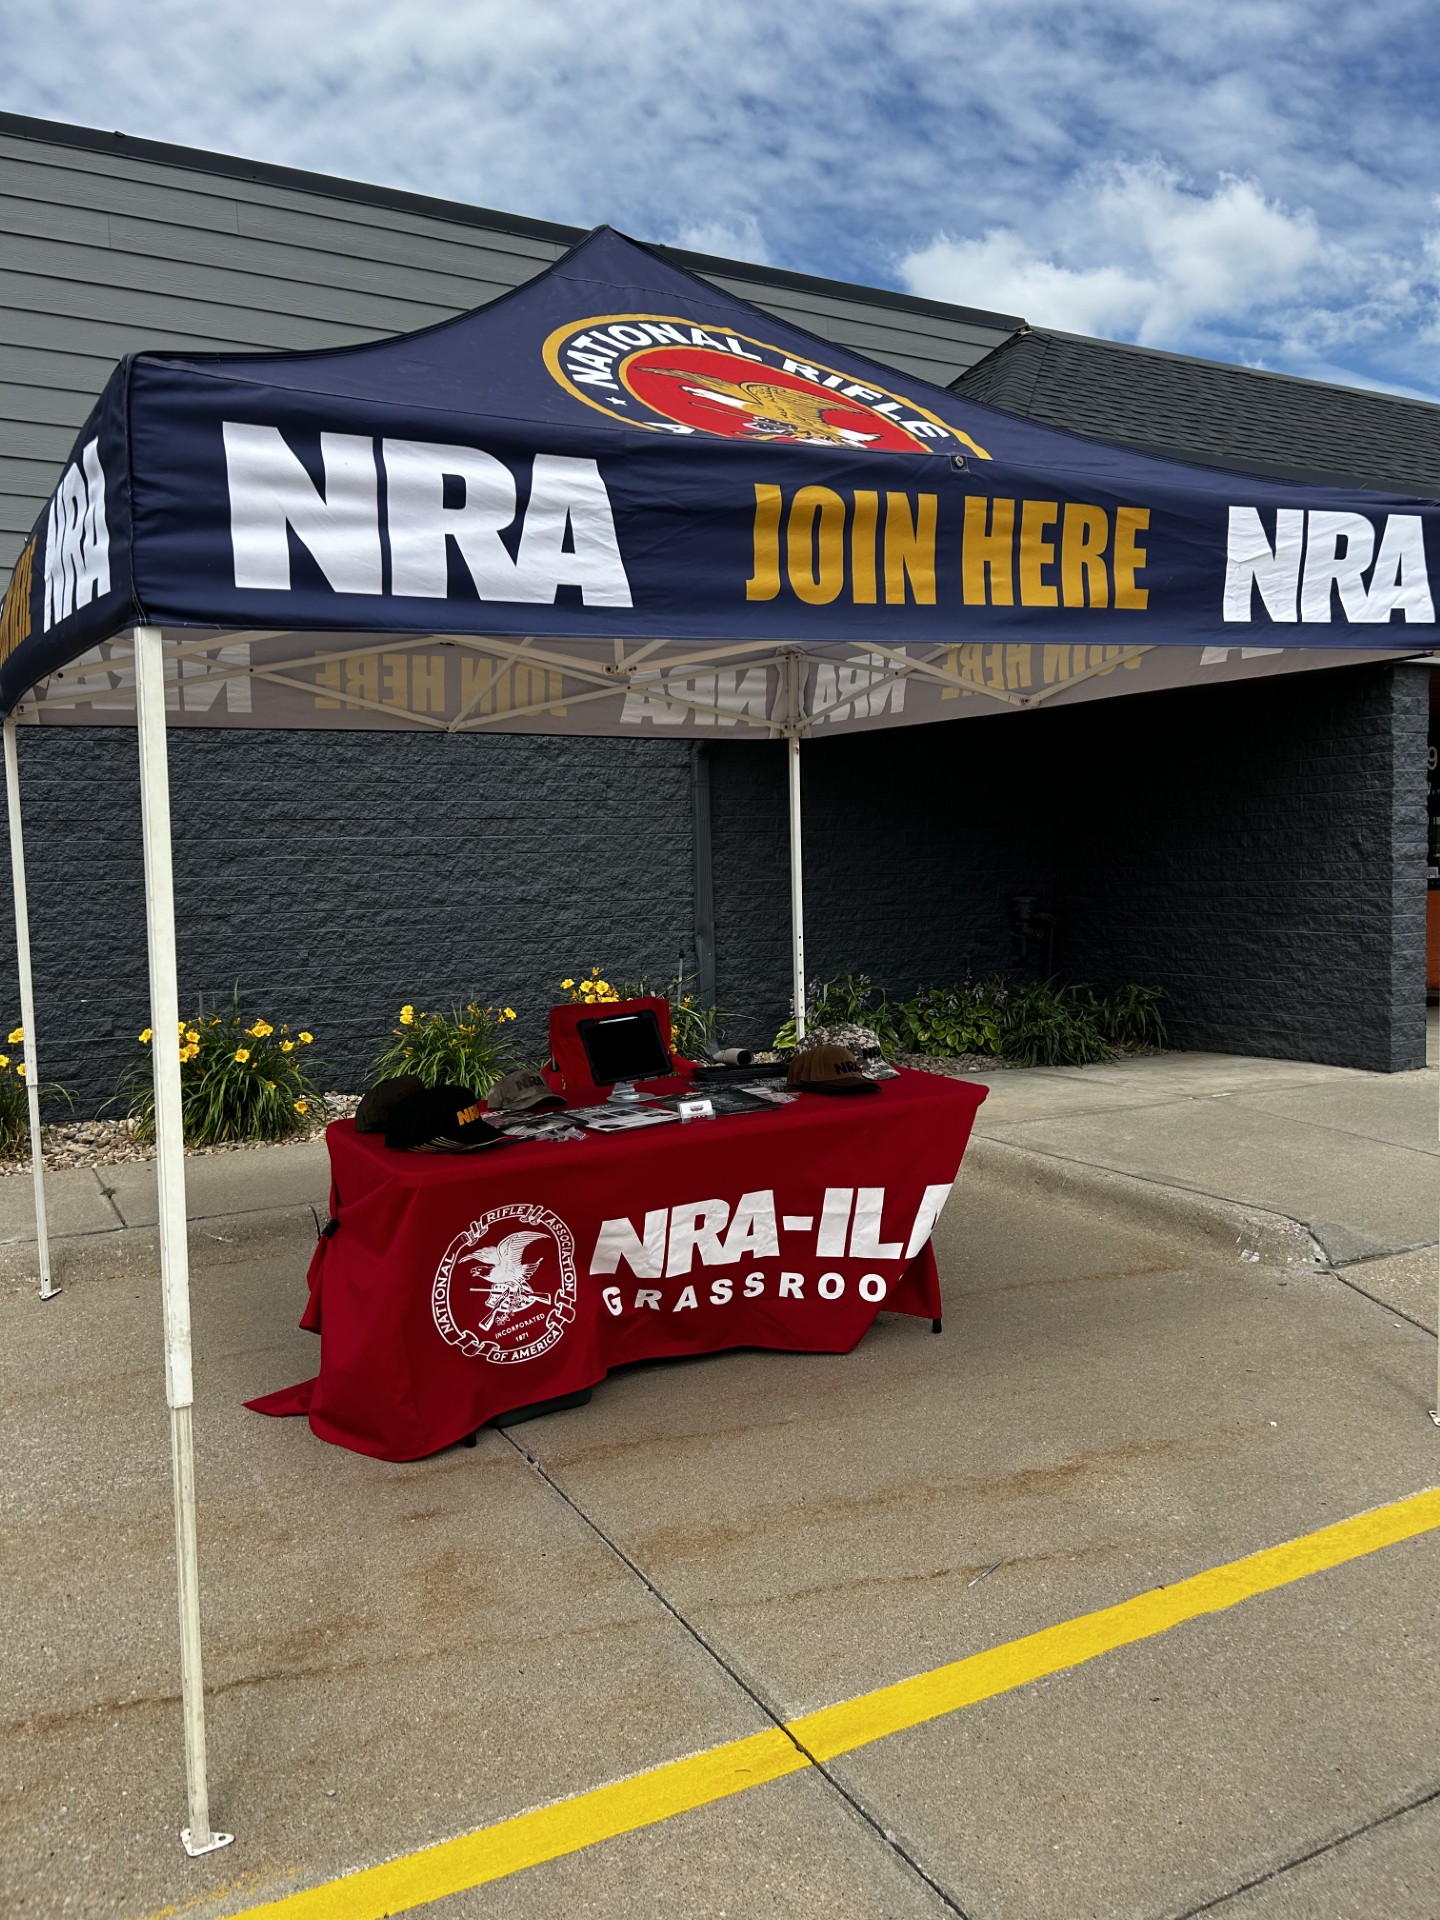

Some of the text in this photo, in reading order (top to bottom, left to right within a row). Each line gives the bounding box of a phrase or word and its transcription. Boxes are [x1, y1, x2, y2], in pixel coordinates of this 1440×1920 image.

[566, 323, 951, 438] NATIONAL RIFLE
[44, 435, 111, 634] NRA
[222, 421, 1436, 624] NRA JOIN HERE NRA
[486, 1206, 526, 1223] RIFLE
[545, 1217, 575, 1293] ASSOCIATION
[434, 1252, 456, 1335] NATIONAL
[495, 1313, 545, 1340] INCORPORATED
[602, 1272, 900, 1316] GRASSROO
[492, 1331, 560, 1362] OF AMERICA
